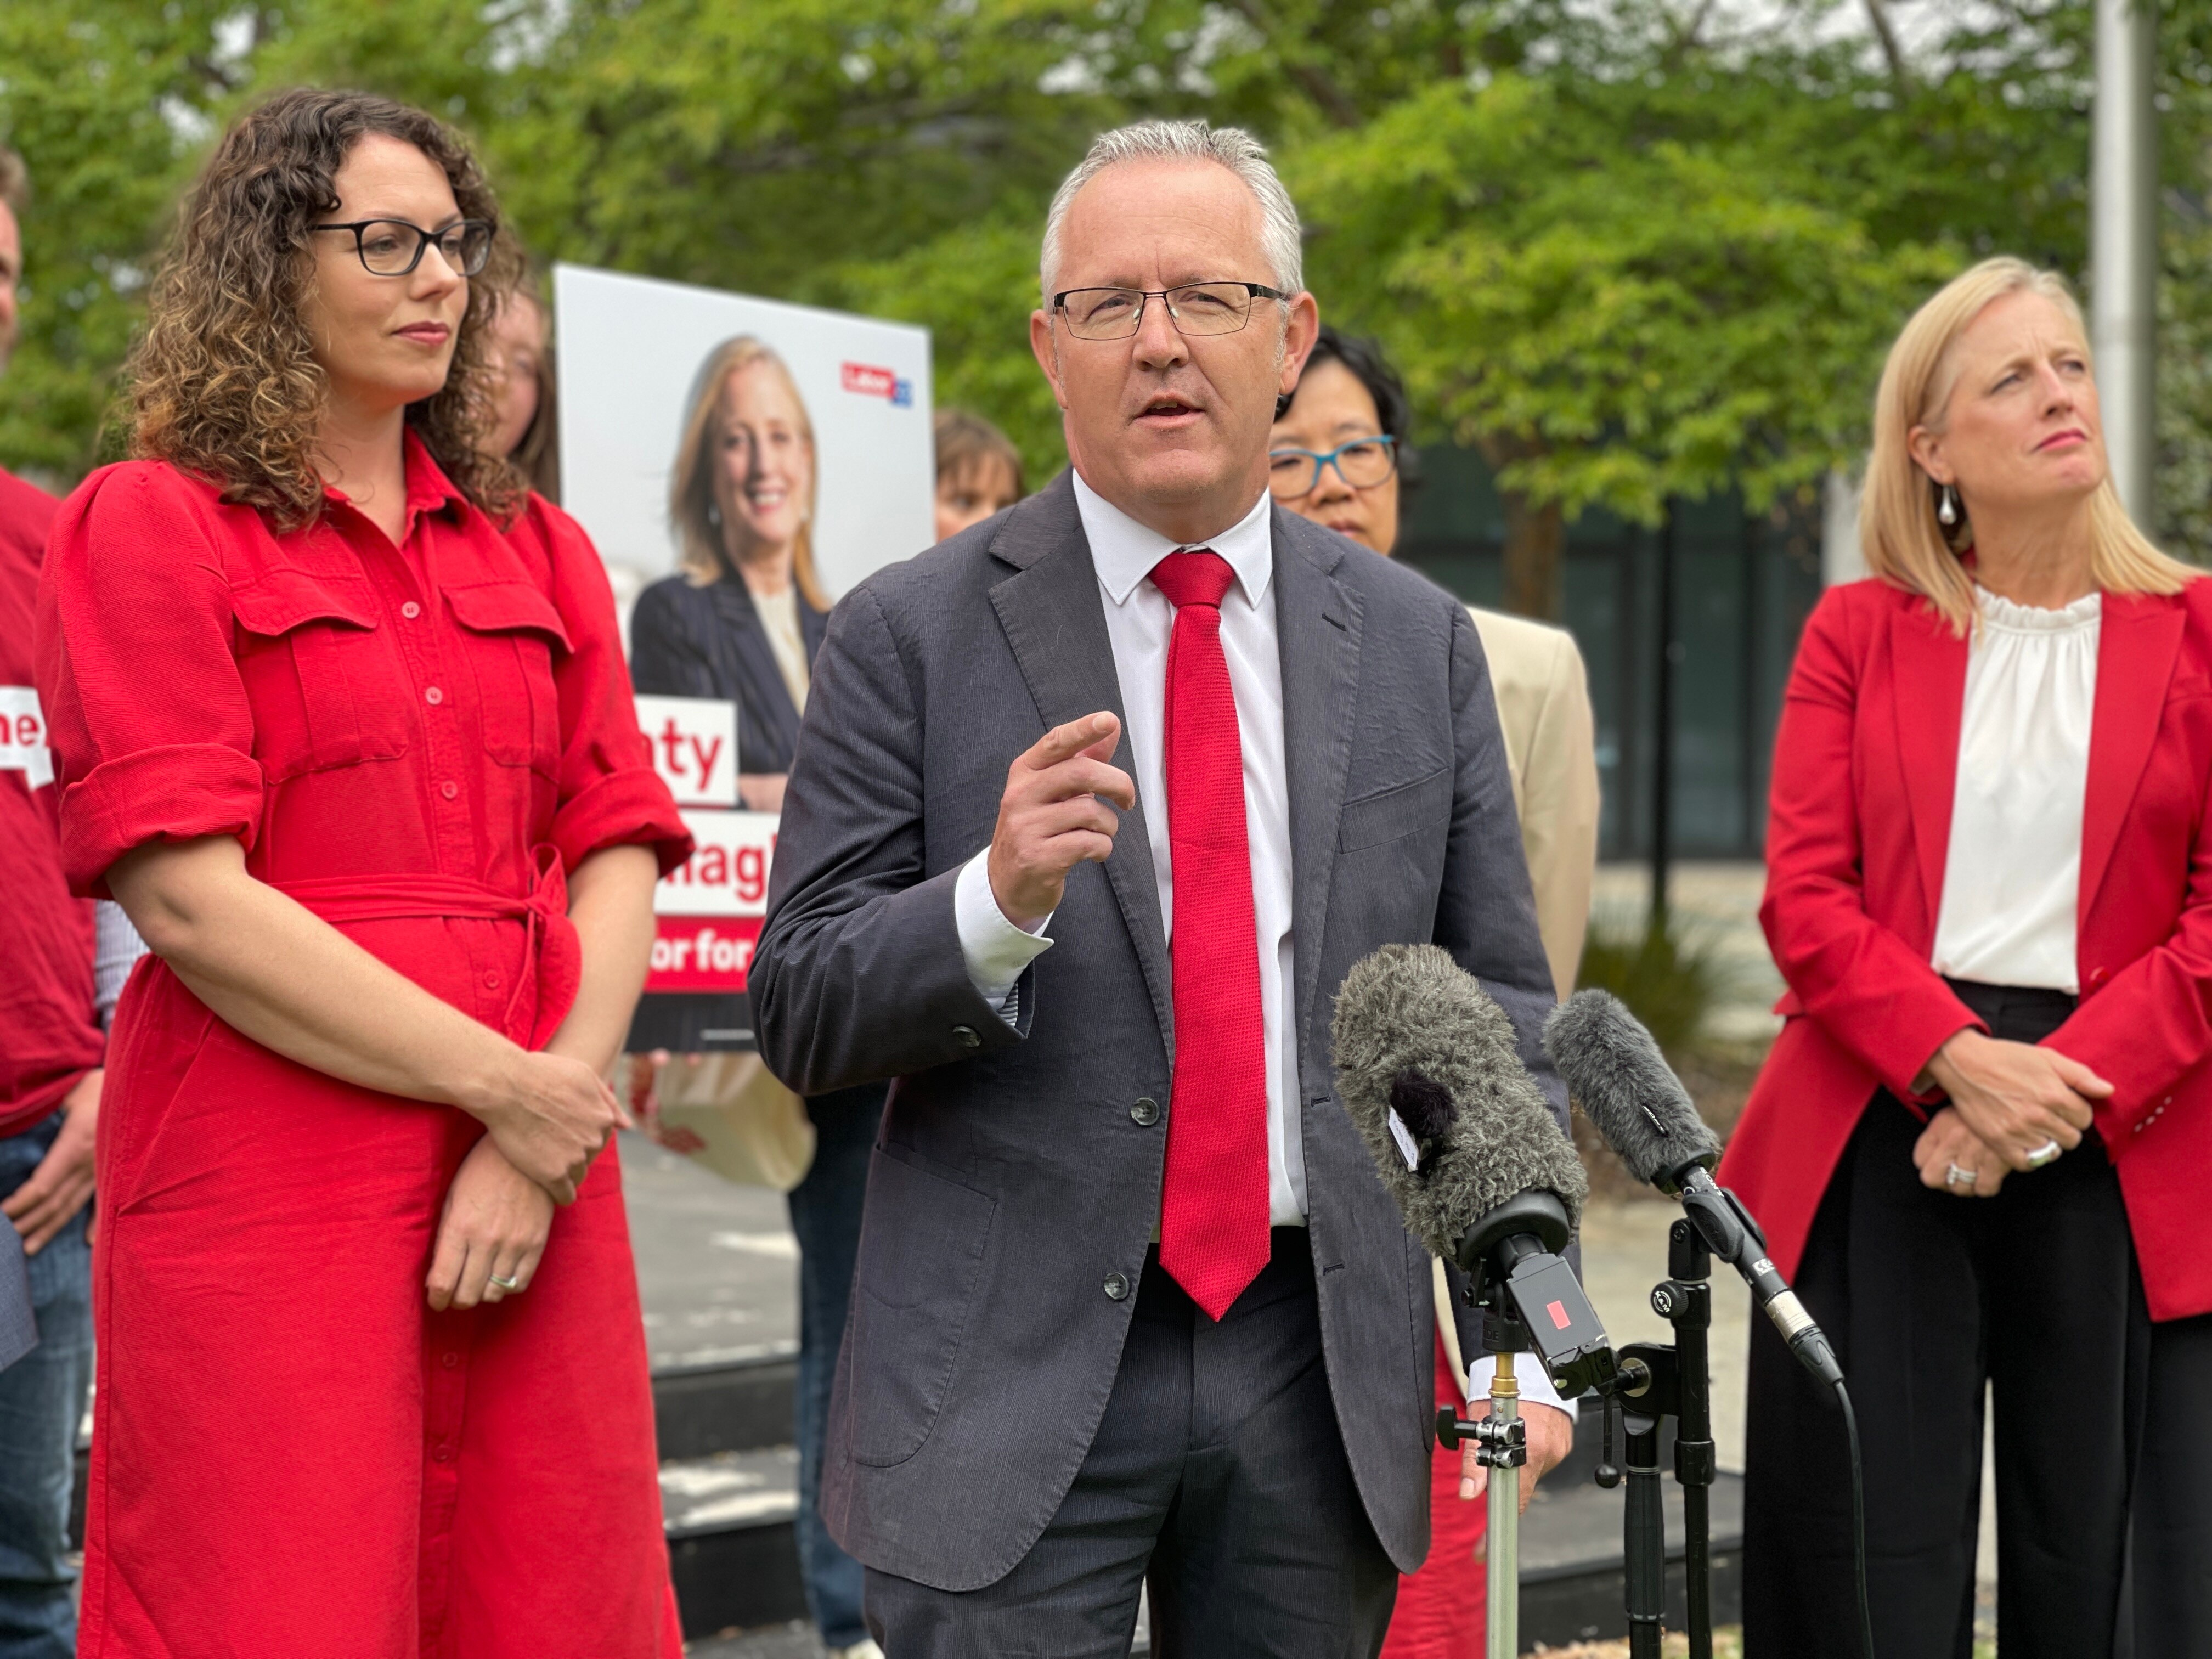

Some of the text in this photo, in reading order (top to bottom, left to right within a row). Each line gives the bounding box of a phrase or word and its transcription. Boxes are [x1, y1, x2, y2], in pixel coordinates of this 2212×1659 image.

[695, 928, 753, 970] for
[1700, 1167, 1725, 1197] SONY
[1655, 1290, 1670, 1313] K&M
